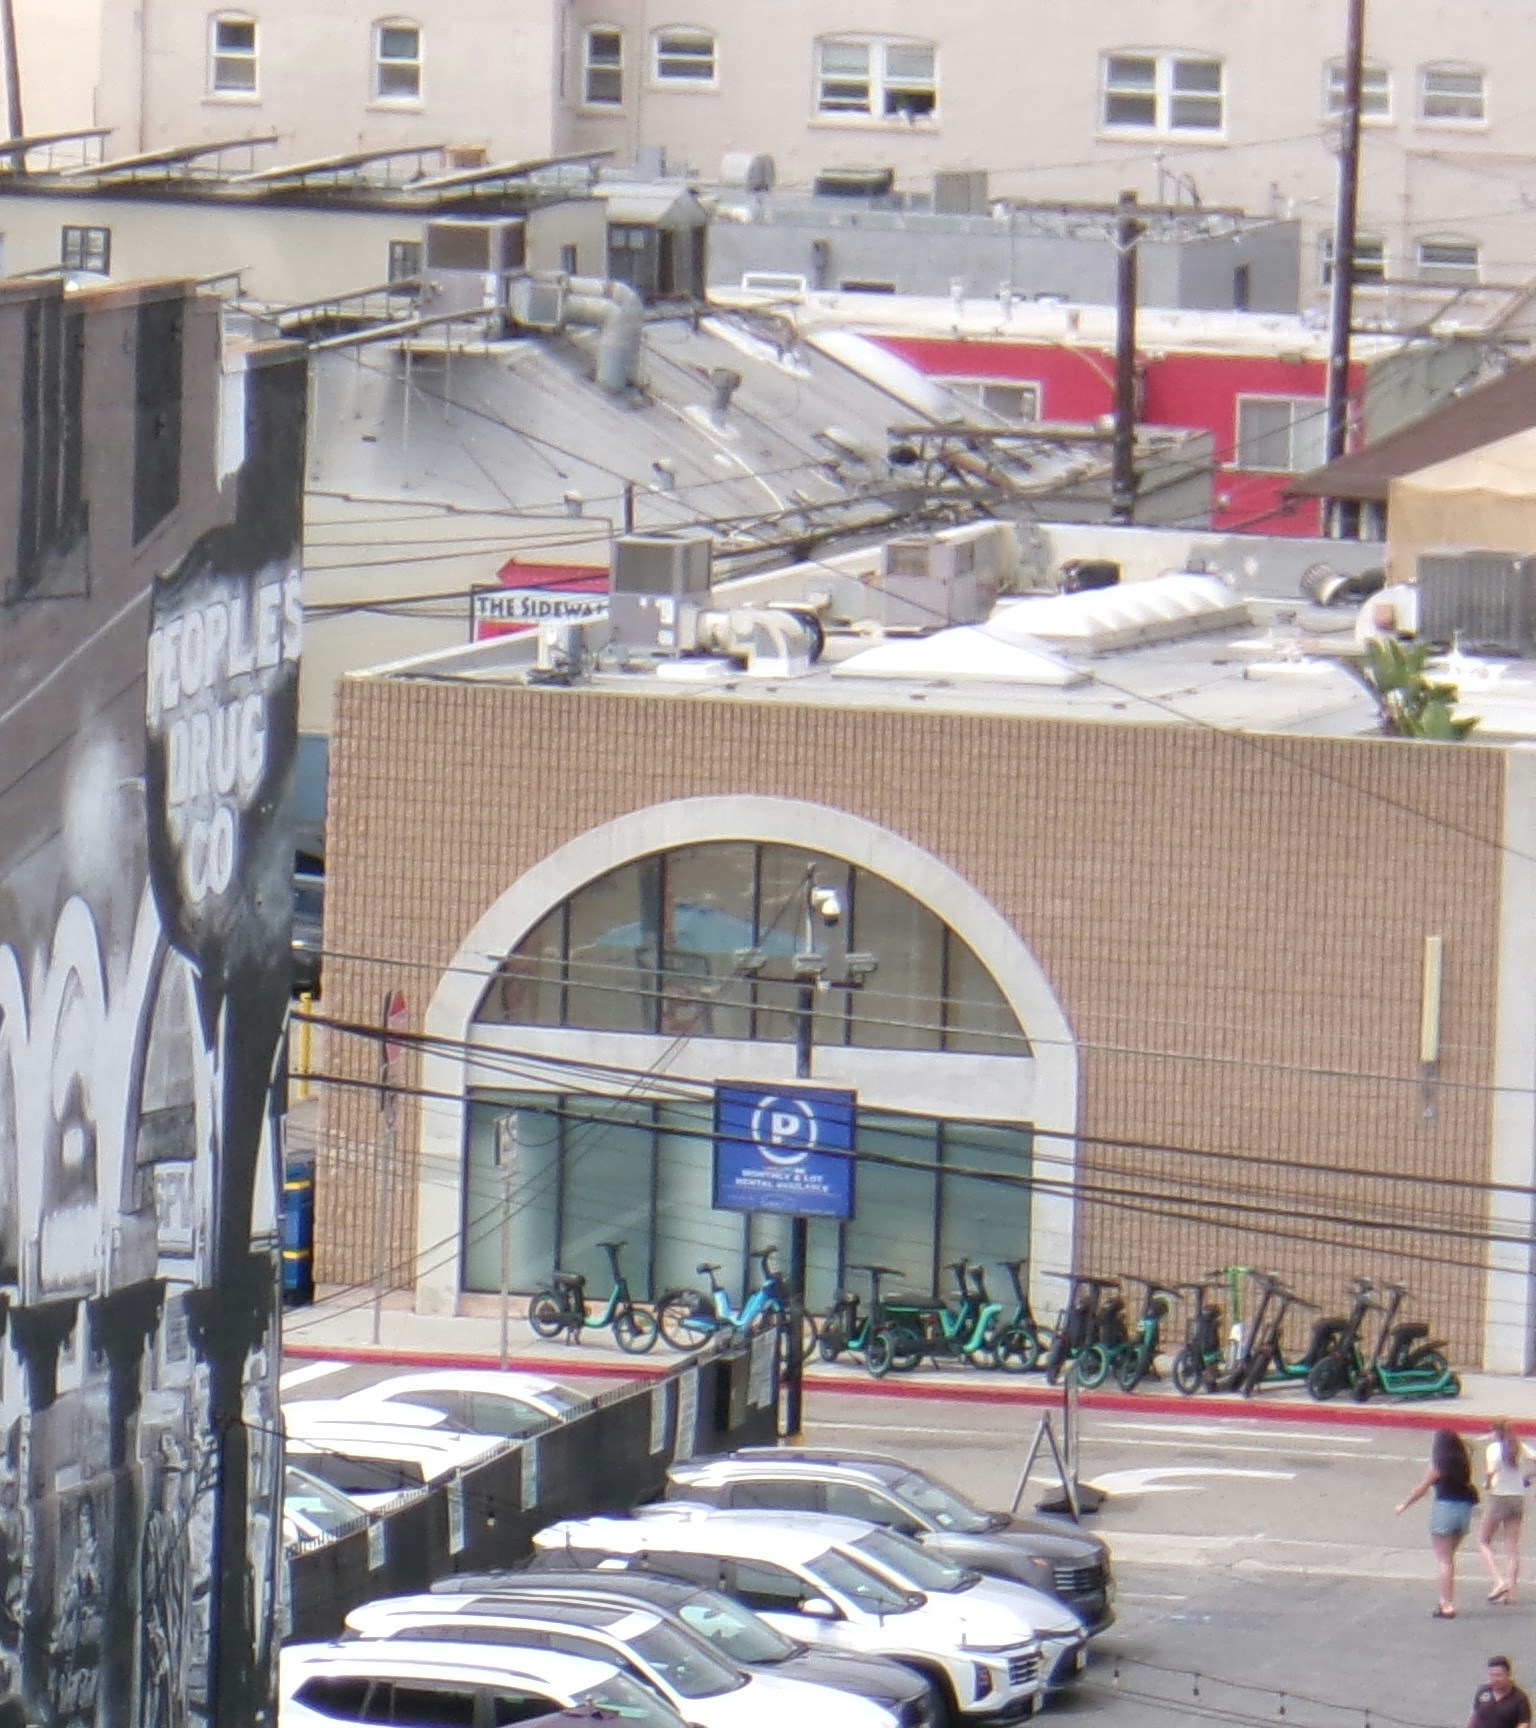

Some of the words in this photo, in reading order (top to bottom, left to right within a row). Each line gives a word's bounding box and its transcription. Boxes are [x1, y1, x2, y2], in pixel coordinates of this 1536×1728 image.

[146, 568, 301, 732] PEOPLES
[478, 597, 514, 617] THE
[166, 694, 269, 810] DRUG
